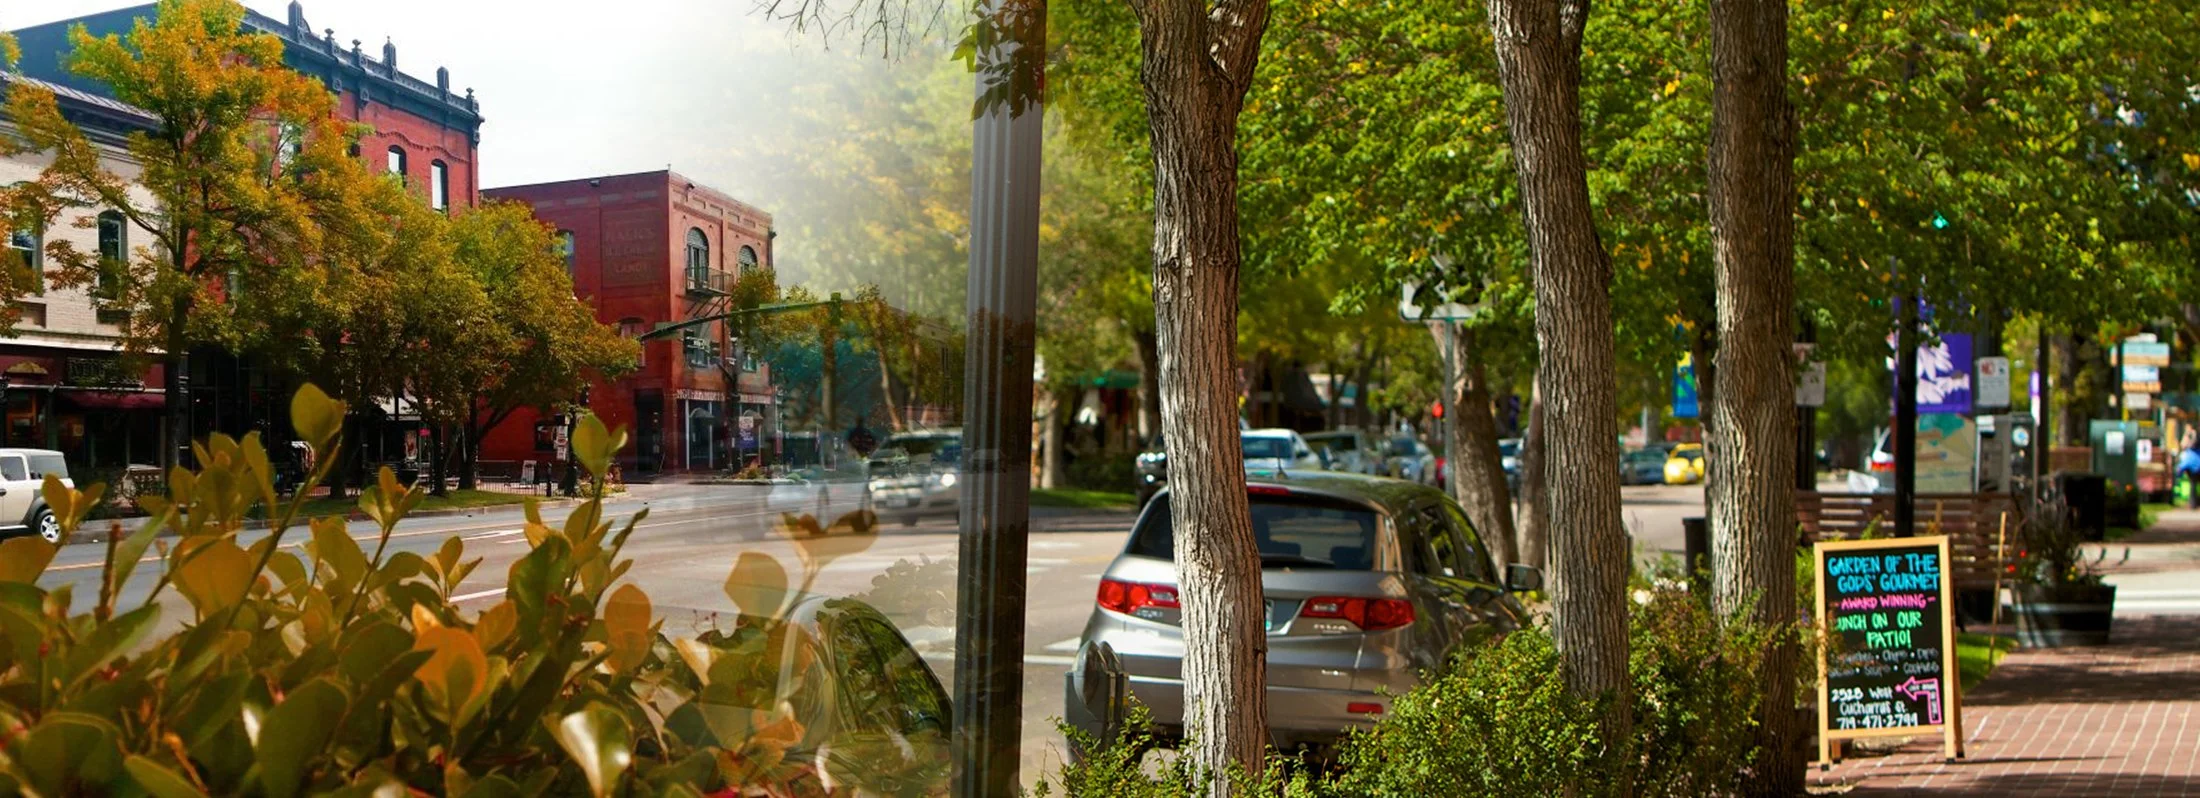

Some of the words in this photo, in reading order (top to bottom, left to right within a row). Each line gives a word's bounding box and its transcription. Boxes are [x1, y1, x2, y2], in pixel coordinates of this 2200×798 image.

[1828, 555, 1881, 576] GARDEN
[1885, 555, 1902, 573] OF
[1905, 553, 1939, 573] THE
[1880, 573, 1940, 592] GOURMET
[1871, 612, 1888, 627] ON
[1897, 611, 1922, 627] OUR
[1866, 629, 1911, 648] PATIO!
